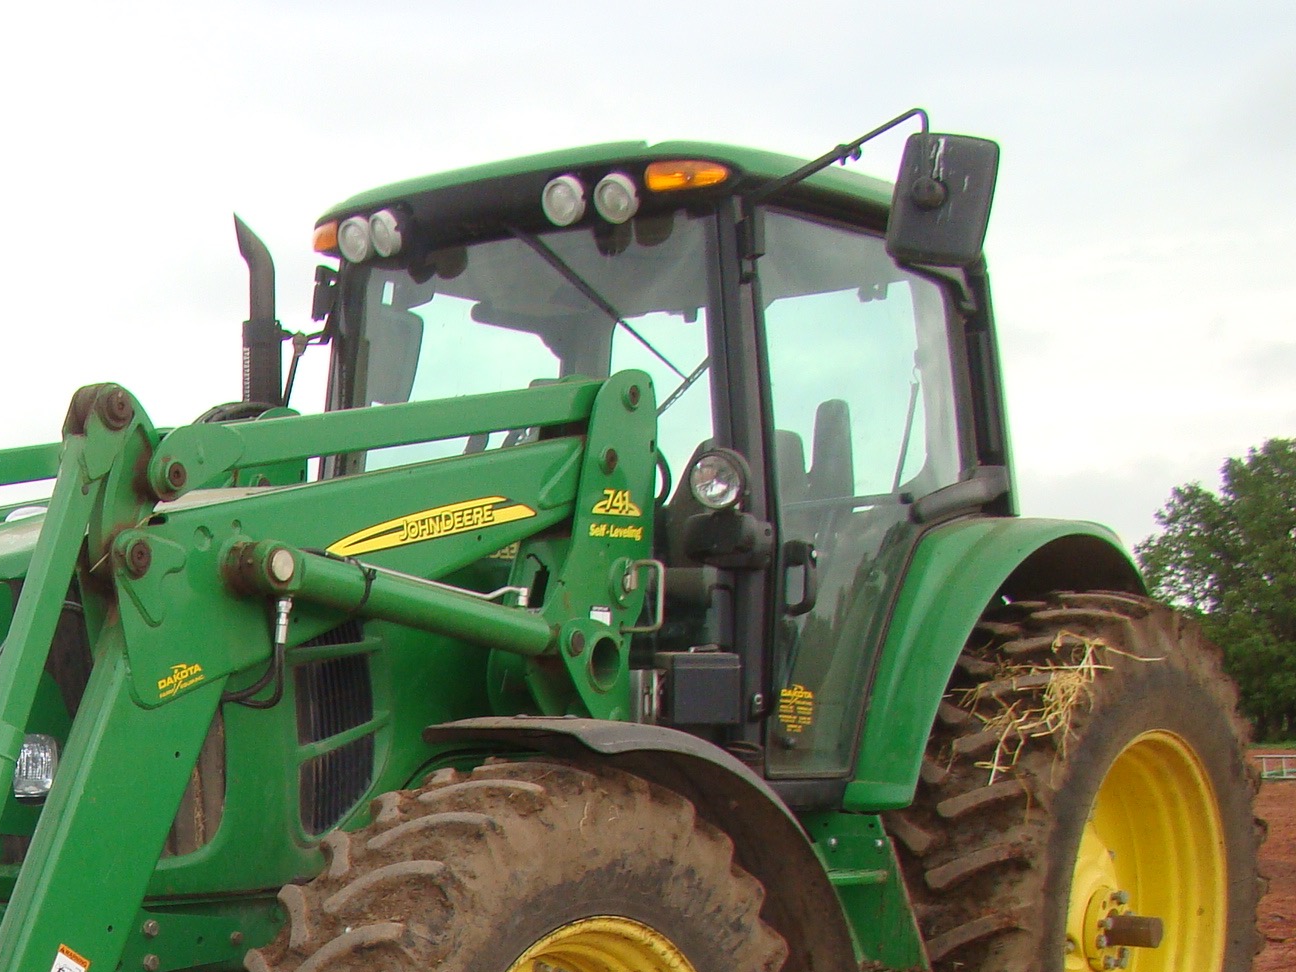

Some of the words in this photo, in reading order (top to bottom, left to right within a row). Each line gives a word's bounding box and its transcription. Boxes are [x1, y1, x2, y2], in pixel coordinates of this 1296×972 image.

[603, 488, 630, 513] 741
[399, 517, 441, 541] JOHN
[441, 504, 495, 532] DEERE
[588, 523, 643, 541] Self-Leveling
[157, 663, 203, 690] DAKOTA
